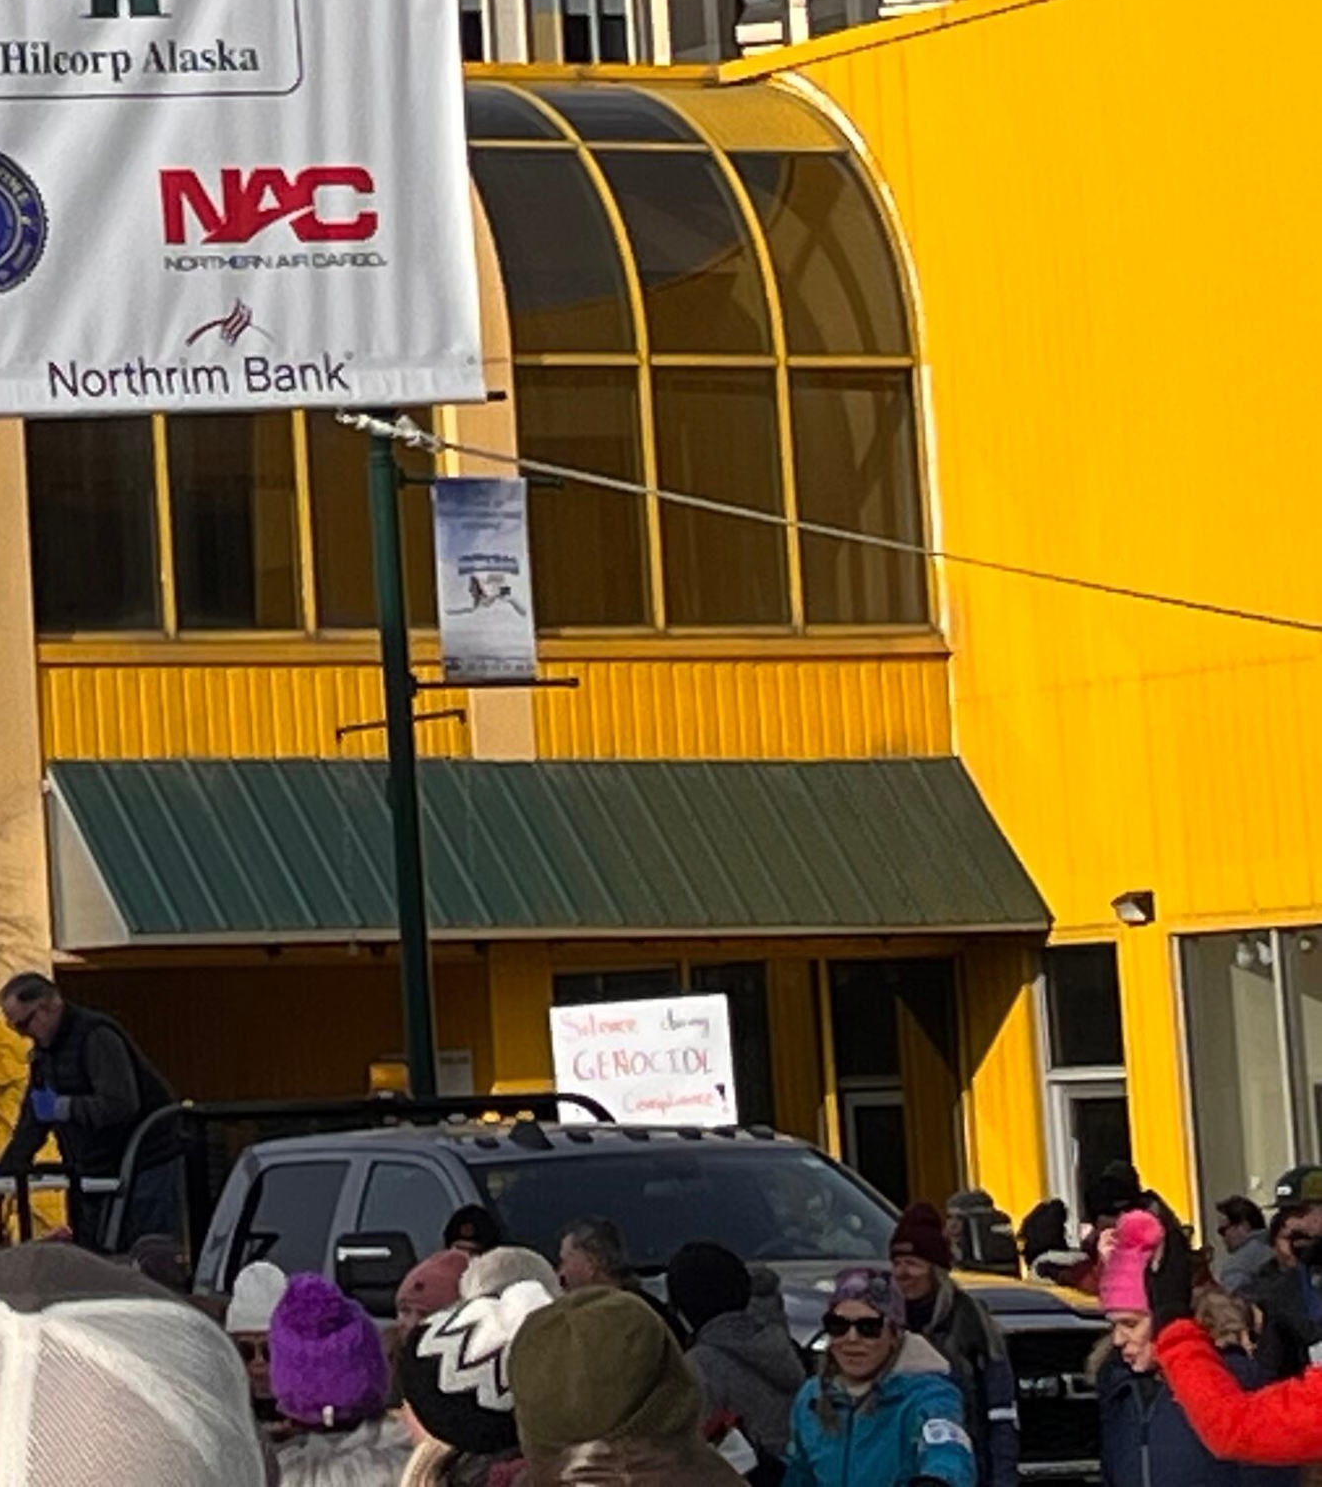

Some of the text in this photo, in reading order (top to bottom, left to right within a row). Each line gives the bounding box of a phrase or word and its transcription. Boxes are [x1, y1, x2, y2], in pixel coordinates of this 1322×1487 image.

[0, 38, 261, 82] Hilcorp Alaska
[158, 165, 379, 244] NAC
[164, 254, 271, 272] NORTHERN
[275, 253, 311, 269] AIR
[47, 352, 351, 399] Northrim Bank
